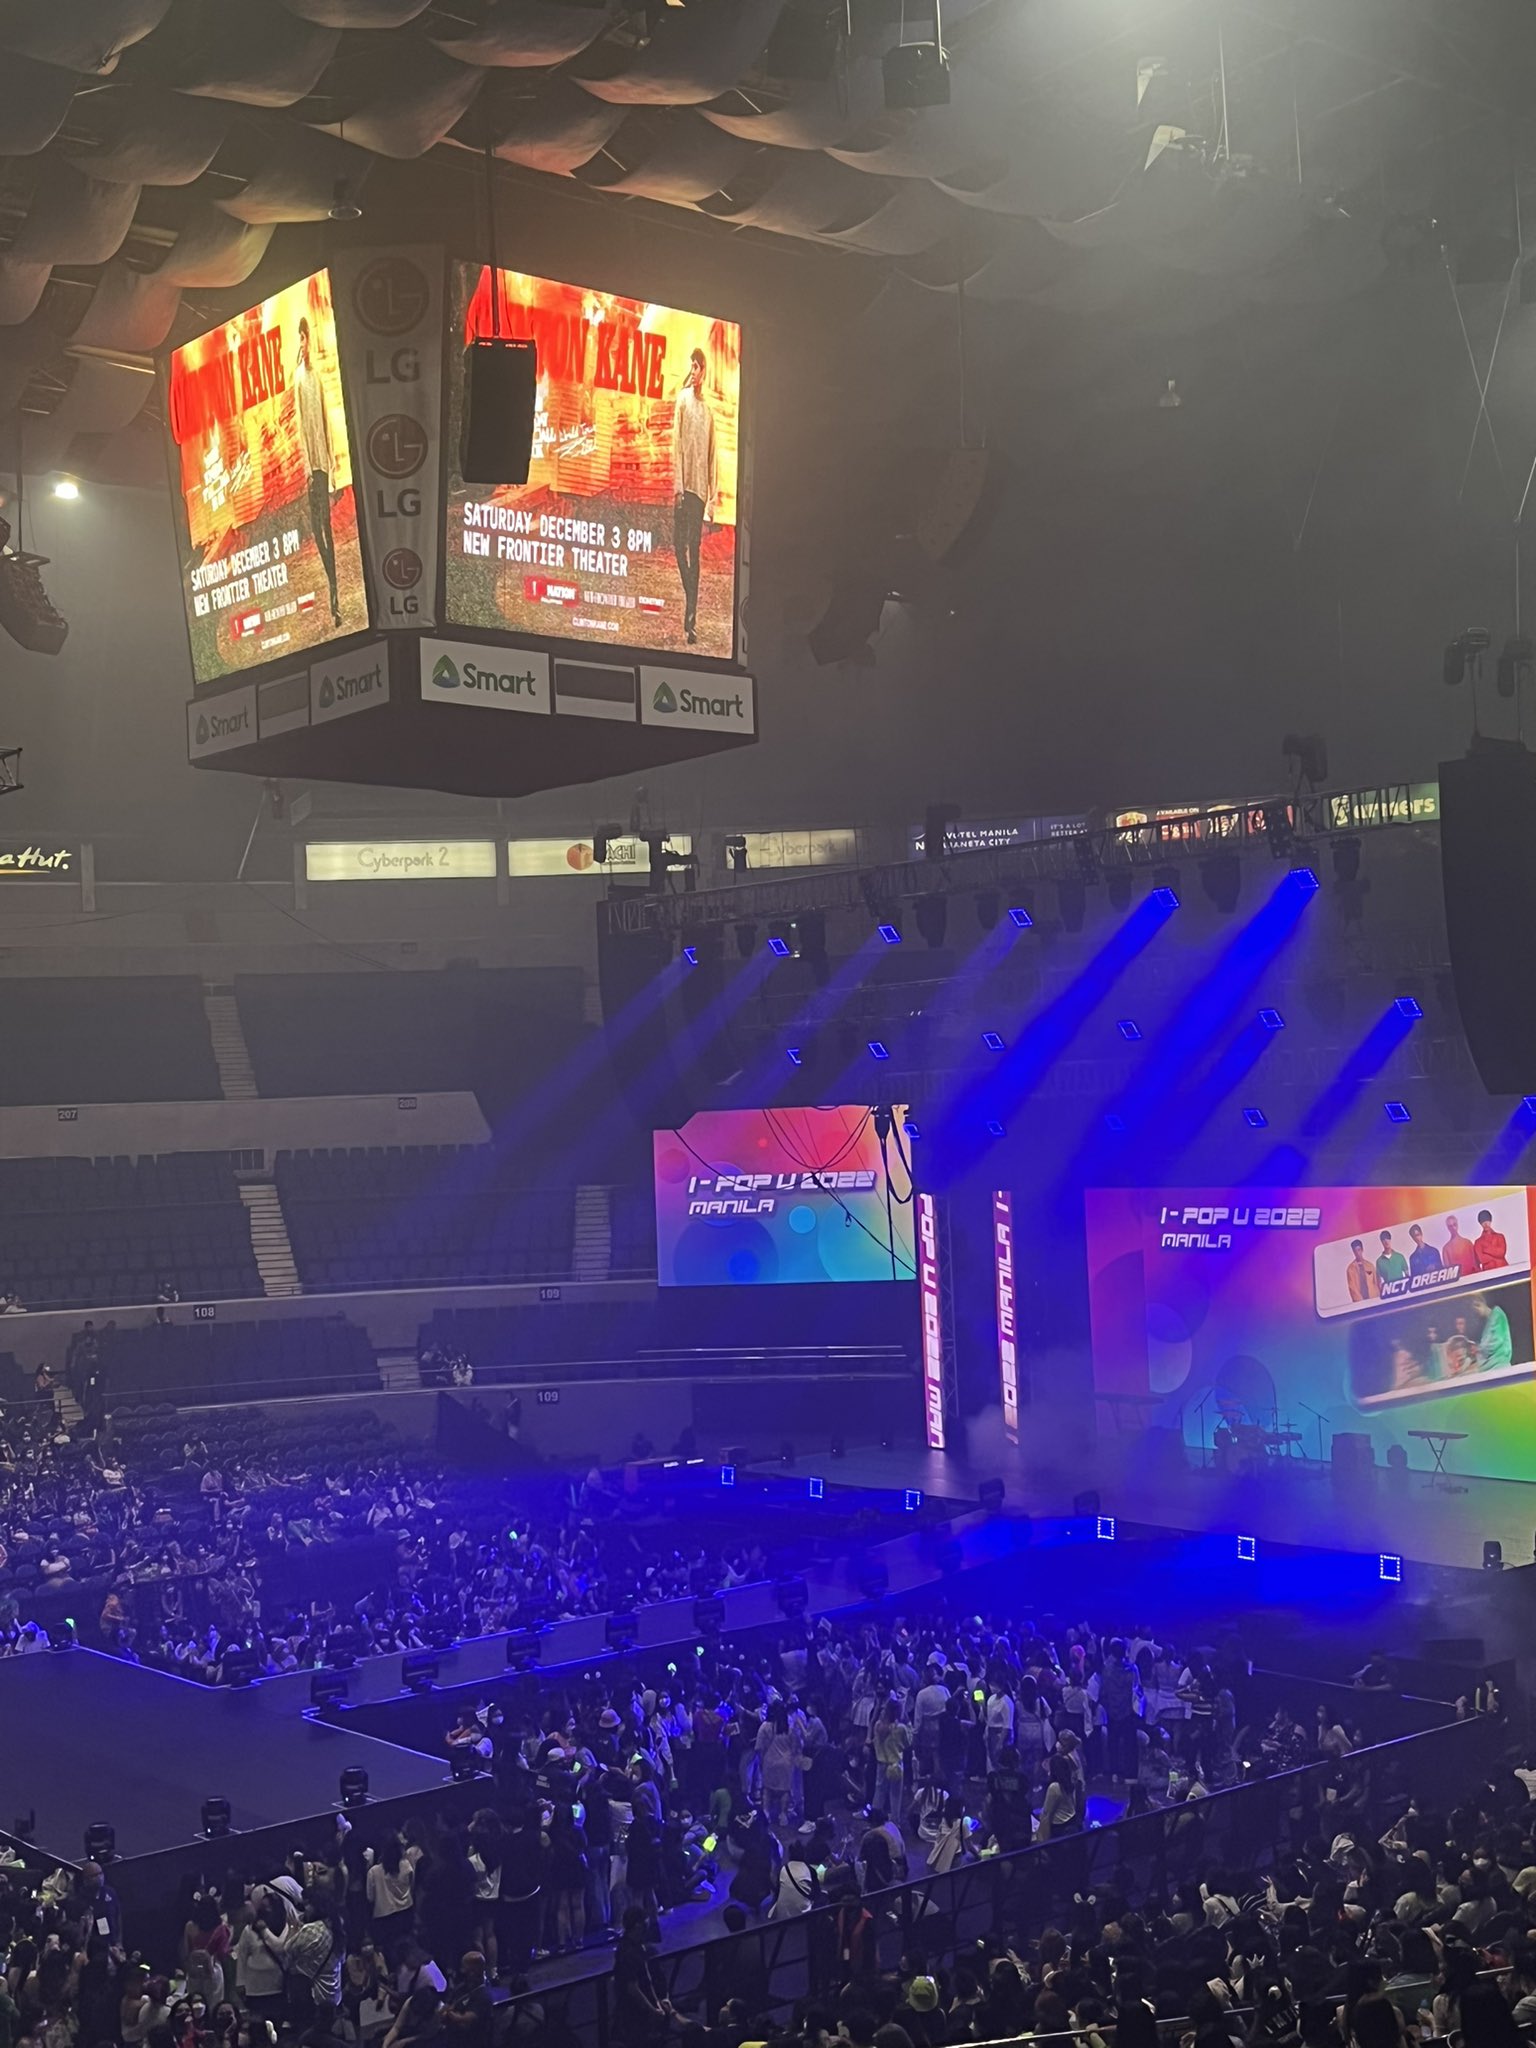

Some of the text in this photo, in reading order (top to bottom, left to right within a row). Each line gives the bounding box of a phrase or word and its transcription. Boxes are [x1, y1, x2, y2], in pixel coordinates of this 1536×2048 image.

[238, 325, 285, 412] KANE
[366, 347, 421, 385] LG
[594, 320, 666, 400] KANE
[377, 488, 421, 518] LG
[464, 501, 652, 553] SATURDAY DECEMBER 3 8PM
[191, 529, 300, 592] SATURDAY DECEMBER 3 8PM
[463, 530, 628, 577] NEW FRONTIER THEATER
[211, 577, 251, 611] FRONTIER
[251, 562, 289, 595] THEATER
[389, 594, 419, 616] LG
[336, 663, 382, 701] Smart
[463, 662, 536, 696] Smart
[680, 688, 744, 719] Smart
[211, 704, 249, 738] Smart
[980, 828, 1019, 837] MANILA
[988, 838, 1011, 846] CITY
[357, 846, 450, 873] Cyberpark 2
[58, 1109, 77, 1119] 207
[776, 1173, 797, 1190] U
[800, 1171, 876, 1189] 2022
[688, 1199, 775, 1215] MANILA
[1233, 1207, 1250, 1225] U
[1253, 1207, 1321, 1226] 2022
[1161, 1233, 1232, 1249] MANILA
[540, 1288, 560, 1299] 109
[996, 1222, 1014, 1336] MANILA
[1381, 1265, 1460, 1296] NCT DREAM
[195, 1307, 215, 1318] 108
[538, 1391, 558, 1402] 109
